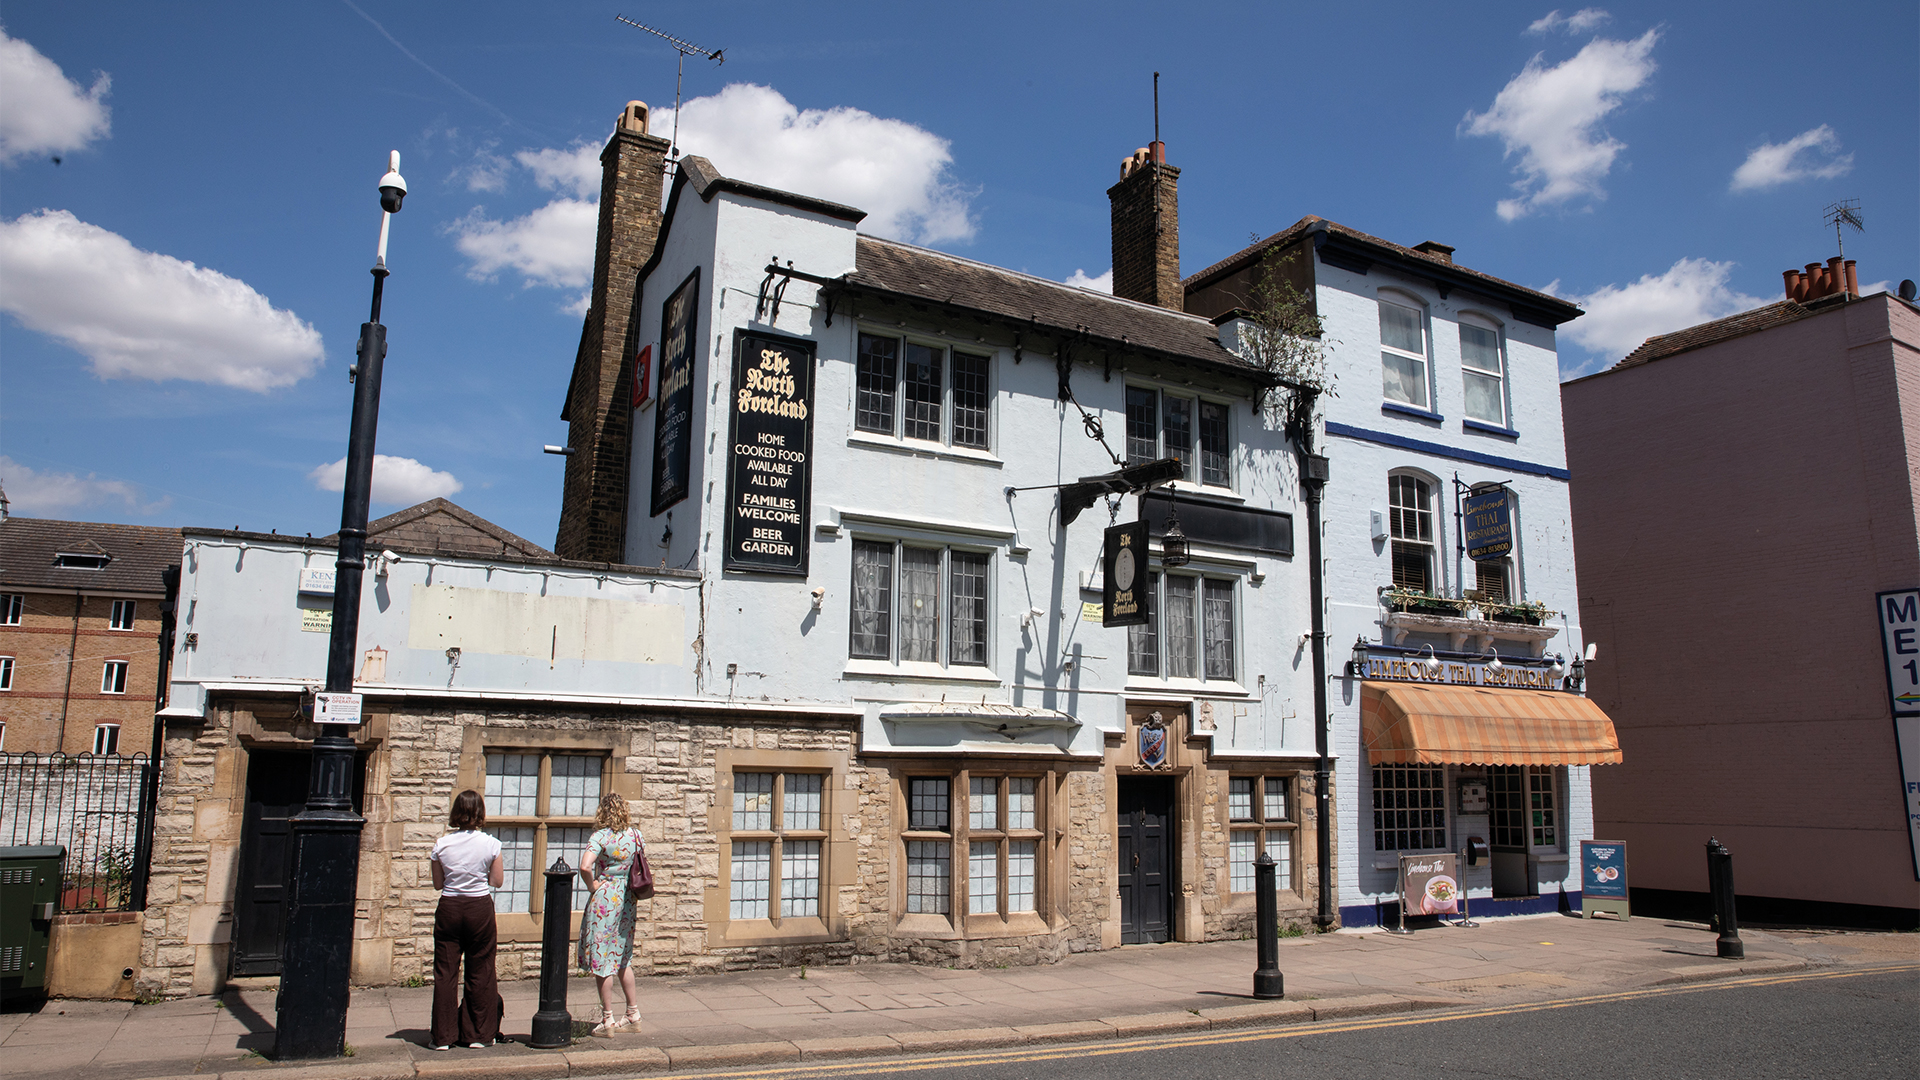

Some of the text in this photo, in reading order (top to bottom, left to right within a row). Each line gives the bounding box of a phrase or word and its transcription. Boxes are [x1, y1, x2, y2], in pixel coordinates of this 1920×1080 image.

[760, 350, 790, 376] The
[746, 368, 795, 400] North
[738, 388, 808, 420] Foreland
[758, 432, 785, 446] HOME
[735, 444, 805, 463] COOKED FOOD
[747, 460, 792, 475] AVAILABLE
[751, 474, 788, 488] ALL DAY
[744, 493, 796, 510] FAMILIES
[738, 506, 800, 524] WELCOME
[1475, 511, 1498, 527] THAI
[753, 528, 782, 540] BEER
[1120, 532, 1131, 547] The
[1468, 524, 1508, 540] RESTAURANT
[741, 541, 794, 556] GARDEN
[1472, 548, 1486, 556] 01634
[1368, 659, 1445, 680] LIMEHOUSE
[1449, 664, 1476, 684] THAI
